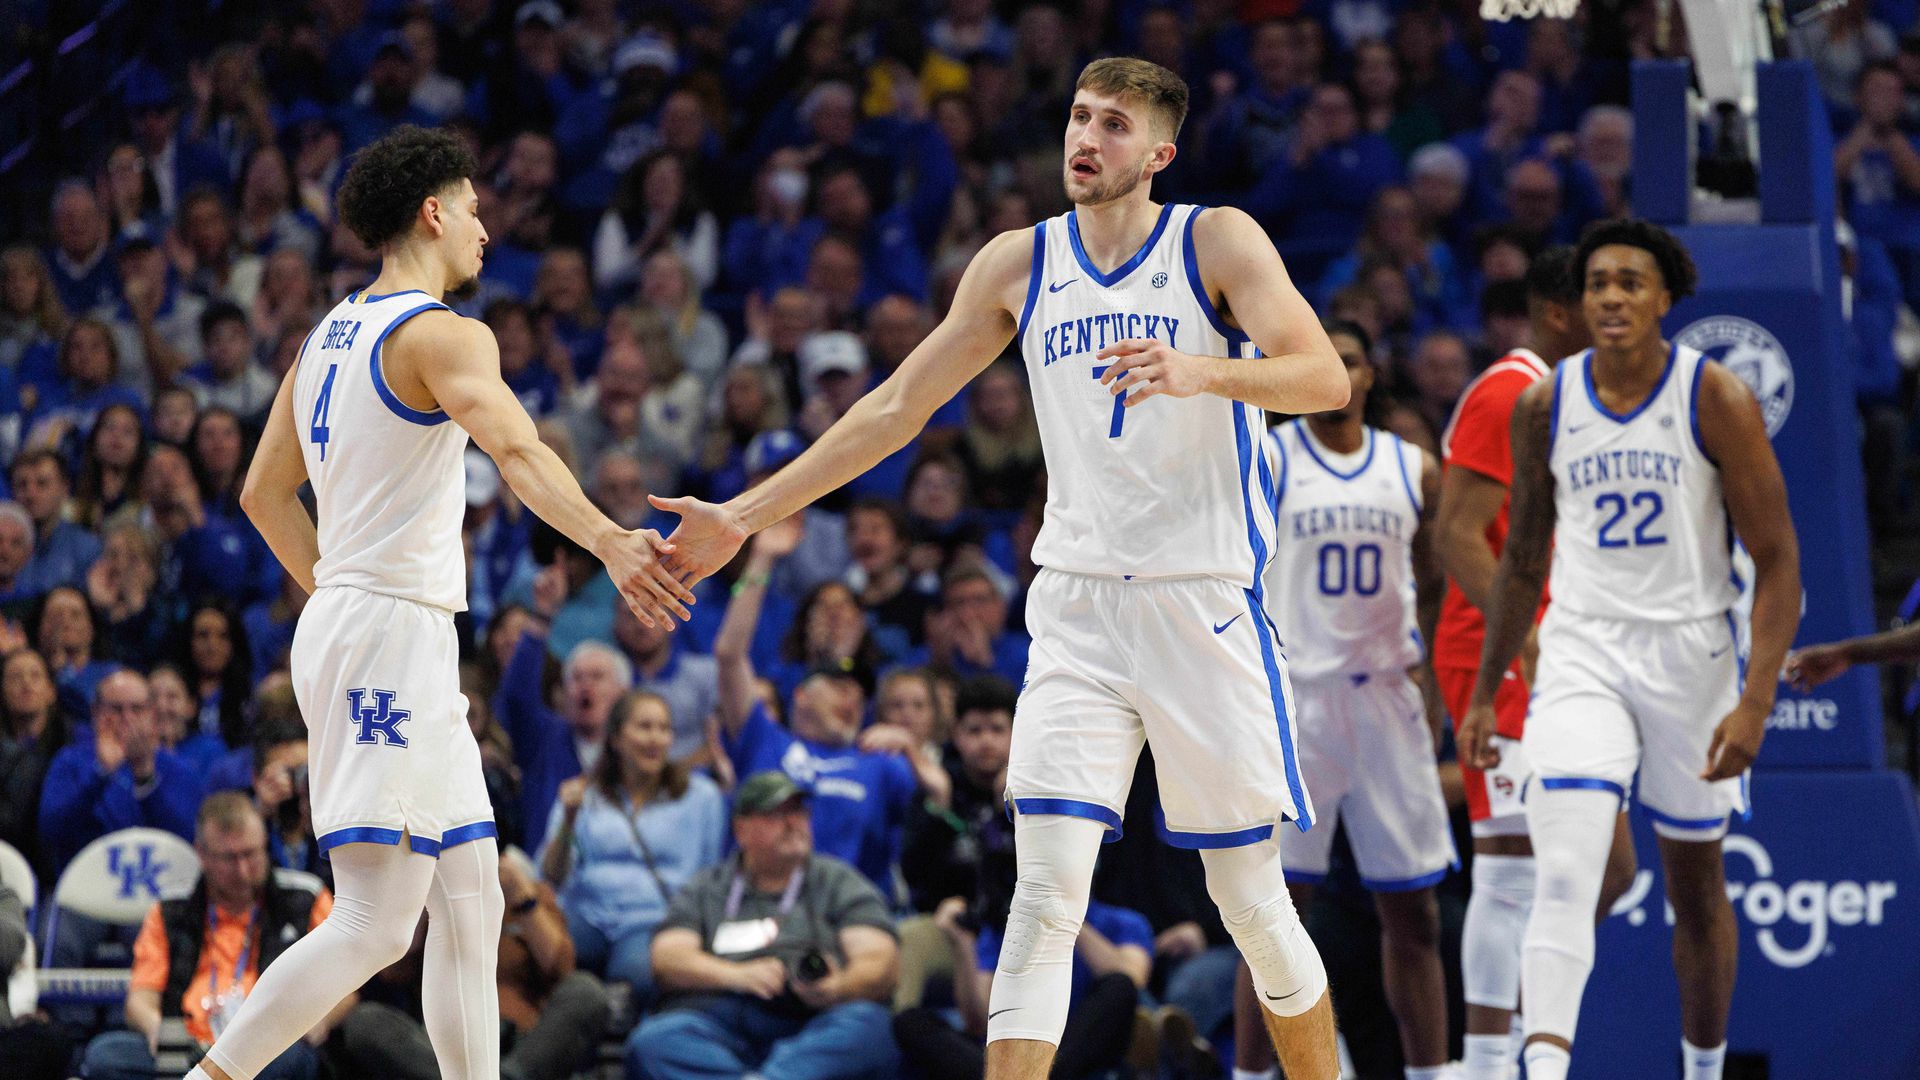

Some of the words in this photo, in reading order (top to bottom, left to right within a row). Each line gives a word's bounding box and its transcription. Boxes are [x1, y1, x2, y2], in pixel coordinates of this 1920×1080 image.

[1152, 272, 1168, 288] SEC
[321, 320, 362, 350] BREA
[1044, 313, 1179, 367] KENTUCKY
[310, 364, 338, 462] 4
[1092, 365, 1129, 438] 7
[1567, 450, 1681, 493] KENTUCKY
[1292, 505, 1402, 540] KENTUCKY
[1595, 491, 1668, 548] 22
[1318, 543, 1382, 596] 00
[347, 688, 411, 748] UK
[107, 843, 170, 898] UK
